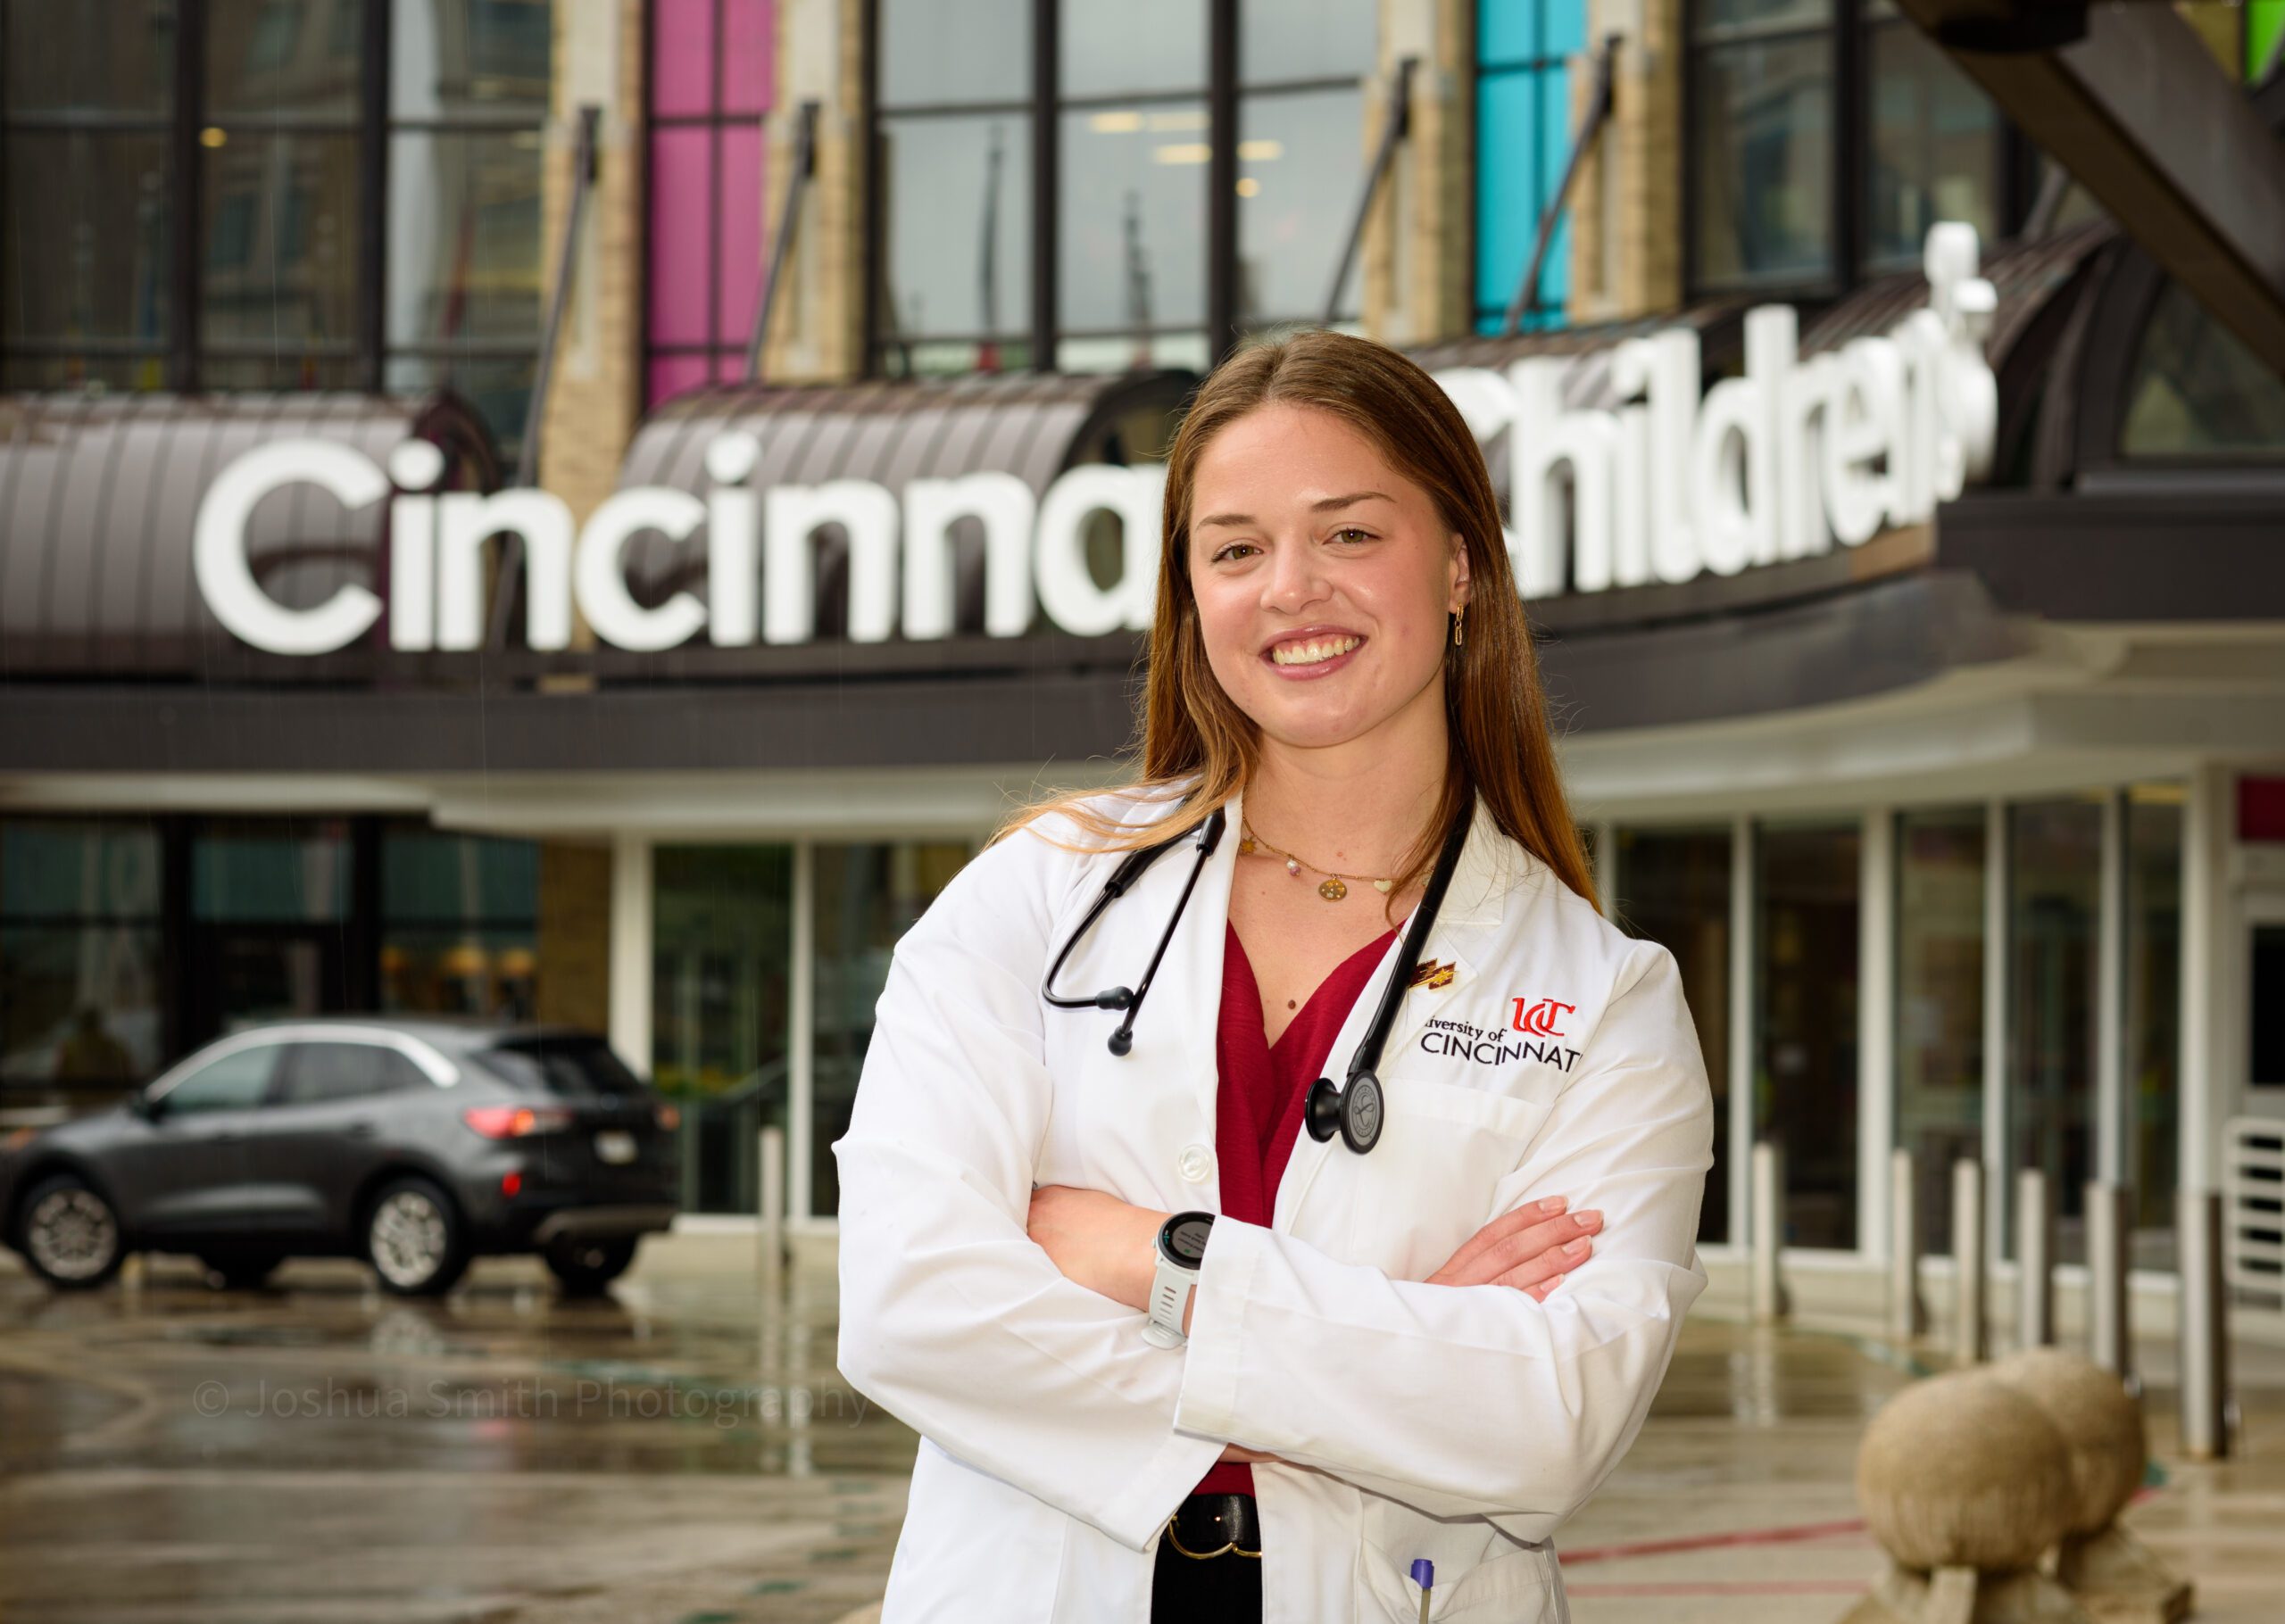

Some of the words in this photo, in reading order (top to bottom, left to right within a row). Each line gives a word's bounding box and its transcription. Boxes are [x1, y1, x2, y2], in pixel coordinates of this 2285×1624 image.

[193, 430, 1168, 656] Cincinna
[1425, 1015, 1483, 1041] iversity
[1489, 1028, 1508, 1043] of
[1421, 1032, 1583, 1073] CINCINNAT
